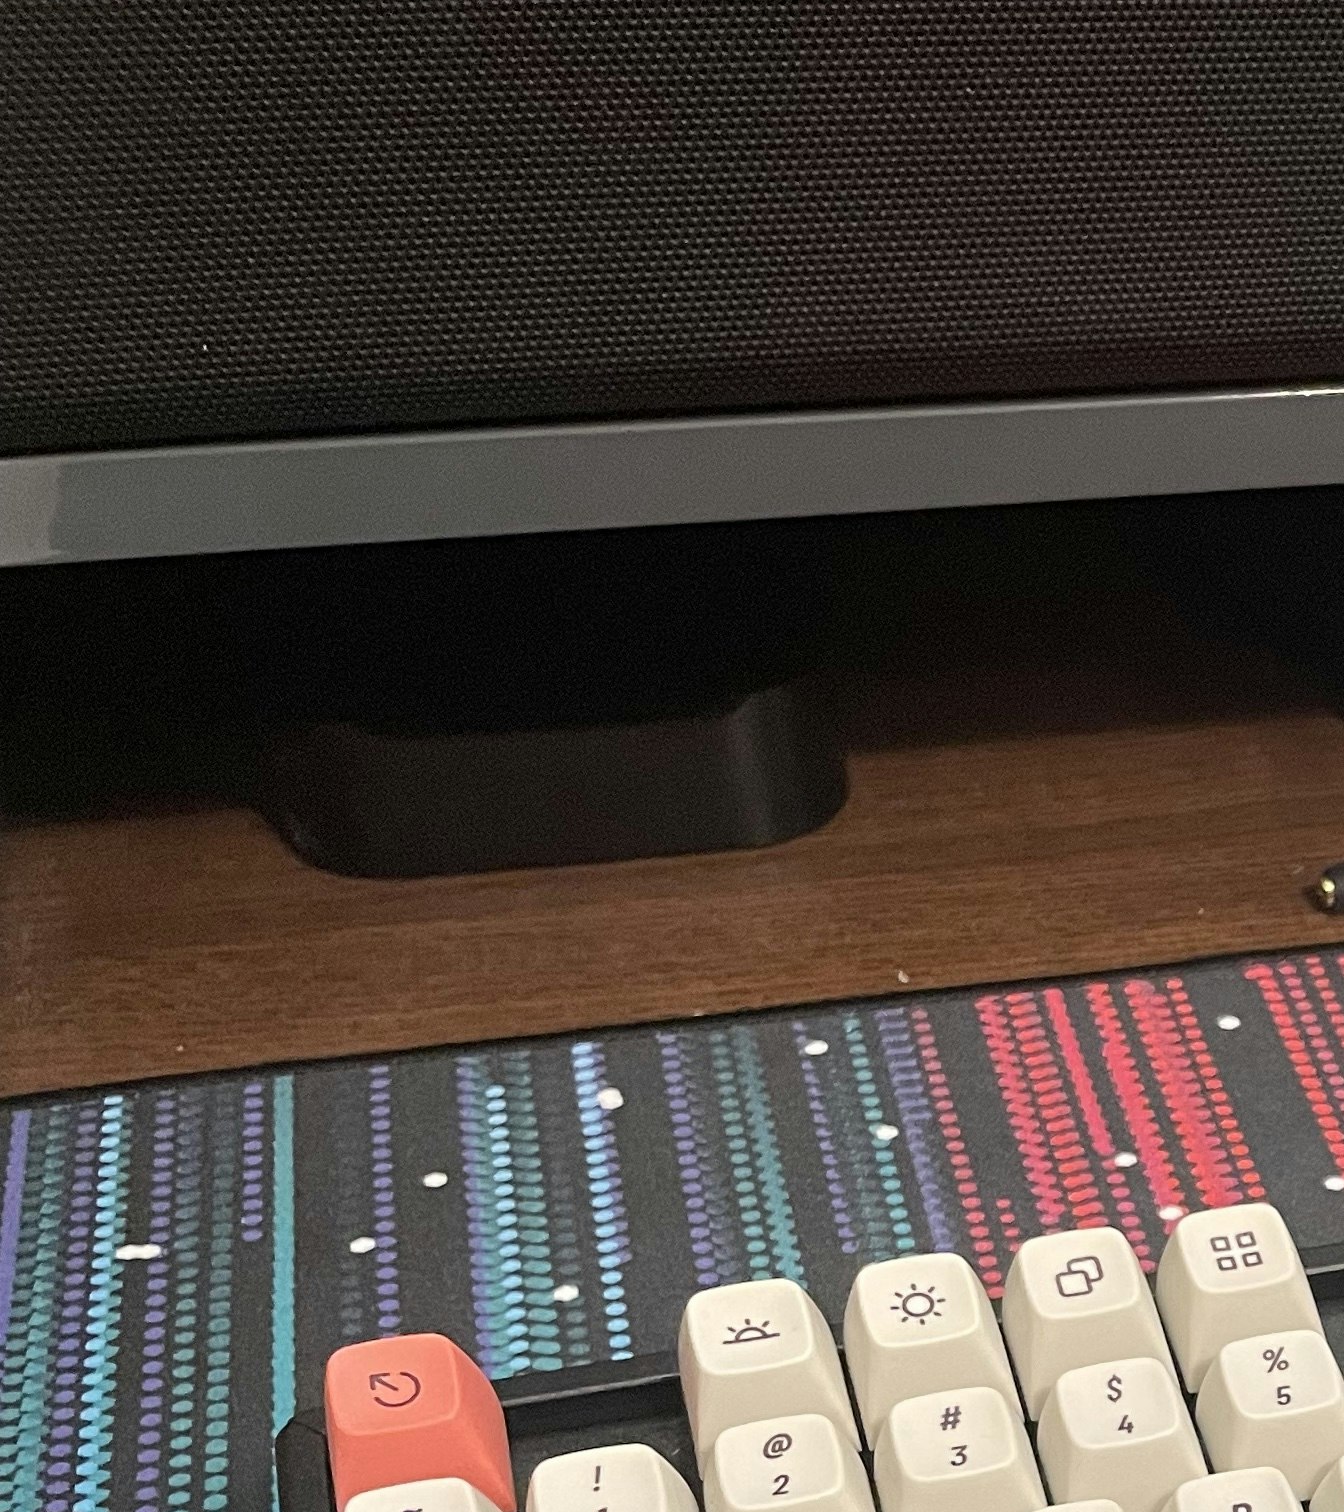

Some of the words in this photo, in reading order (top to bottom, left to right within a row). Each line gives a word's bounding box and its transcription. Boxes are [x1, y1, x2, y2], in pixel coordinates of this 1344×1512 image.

[1262, 1346, 1290, 1374] %
[1107, 1374, 1122, 1403] $
[1276, 1385, 1292, 1406] 5
[939, 1405, 962, 1432] #
[1117, 1414, 1134, 1434] 4
[762, 1433, 793, 1460] @
[950, 1444, 968, 1467] 3
[592, 1465, 601, 1492] !
[772, 1474, 790, 1496] 2
